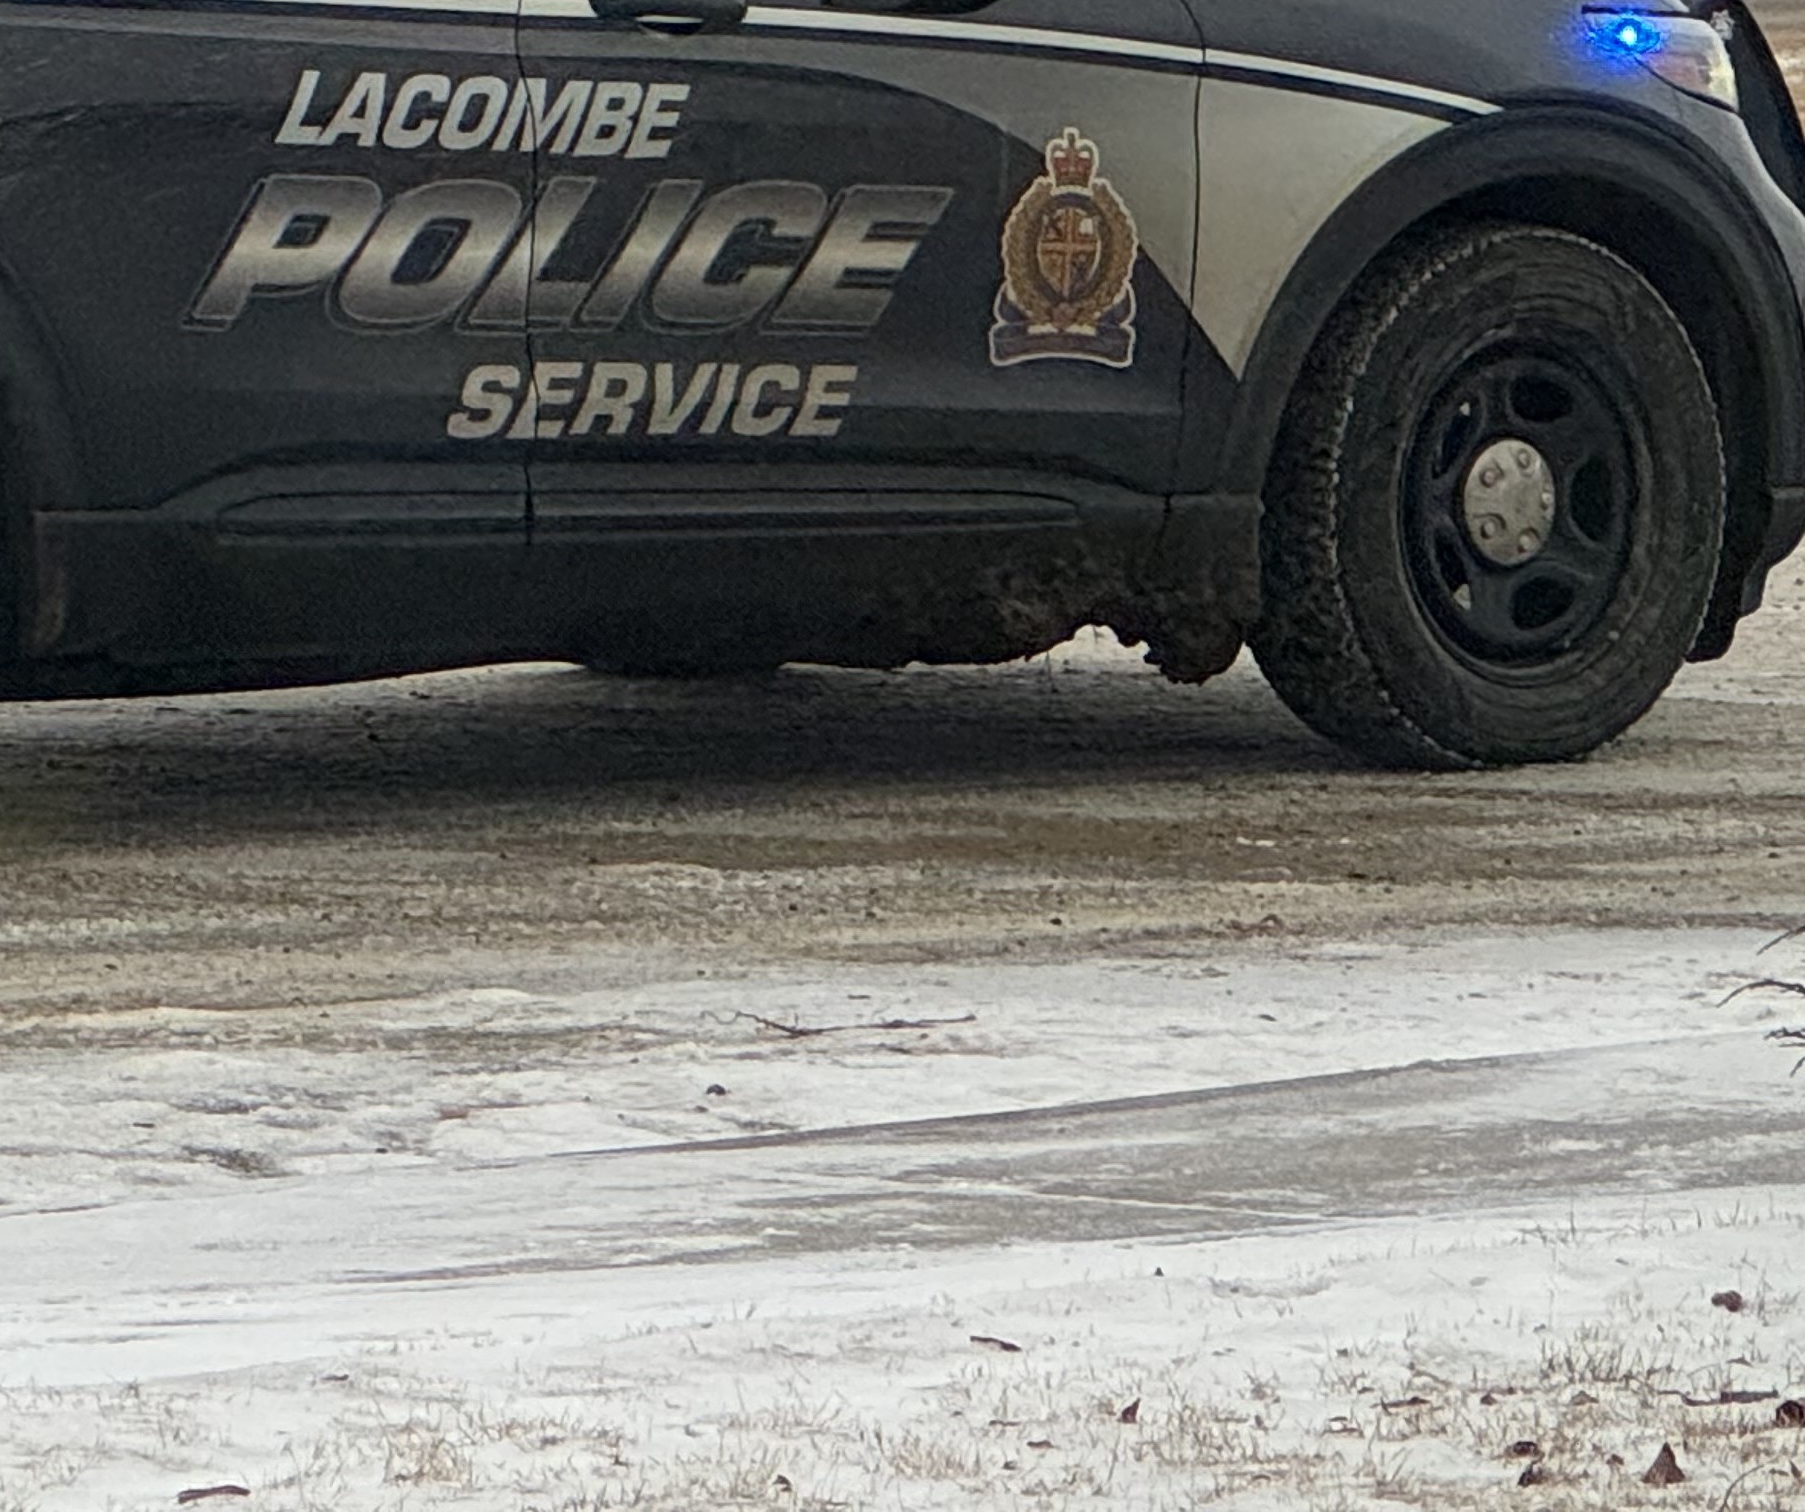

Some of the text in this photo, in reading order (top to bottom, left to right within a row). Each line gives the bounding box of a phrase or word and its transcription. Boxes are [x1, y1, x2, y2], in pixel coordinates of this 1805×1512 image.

[275, 70, 691, 159] LACOMBE
[181, 173, 954, 336] POLICE
[447, 361, 858, 440] SERVICE
